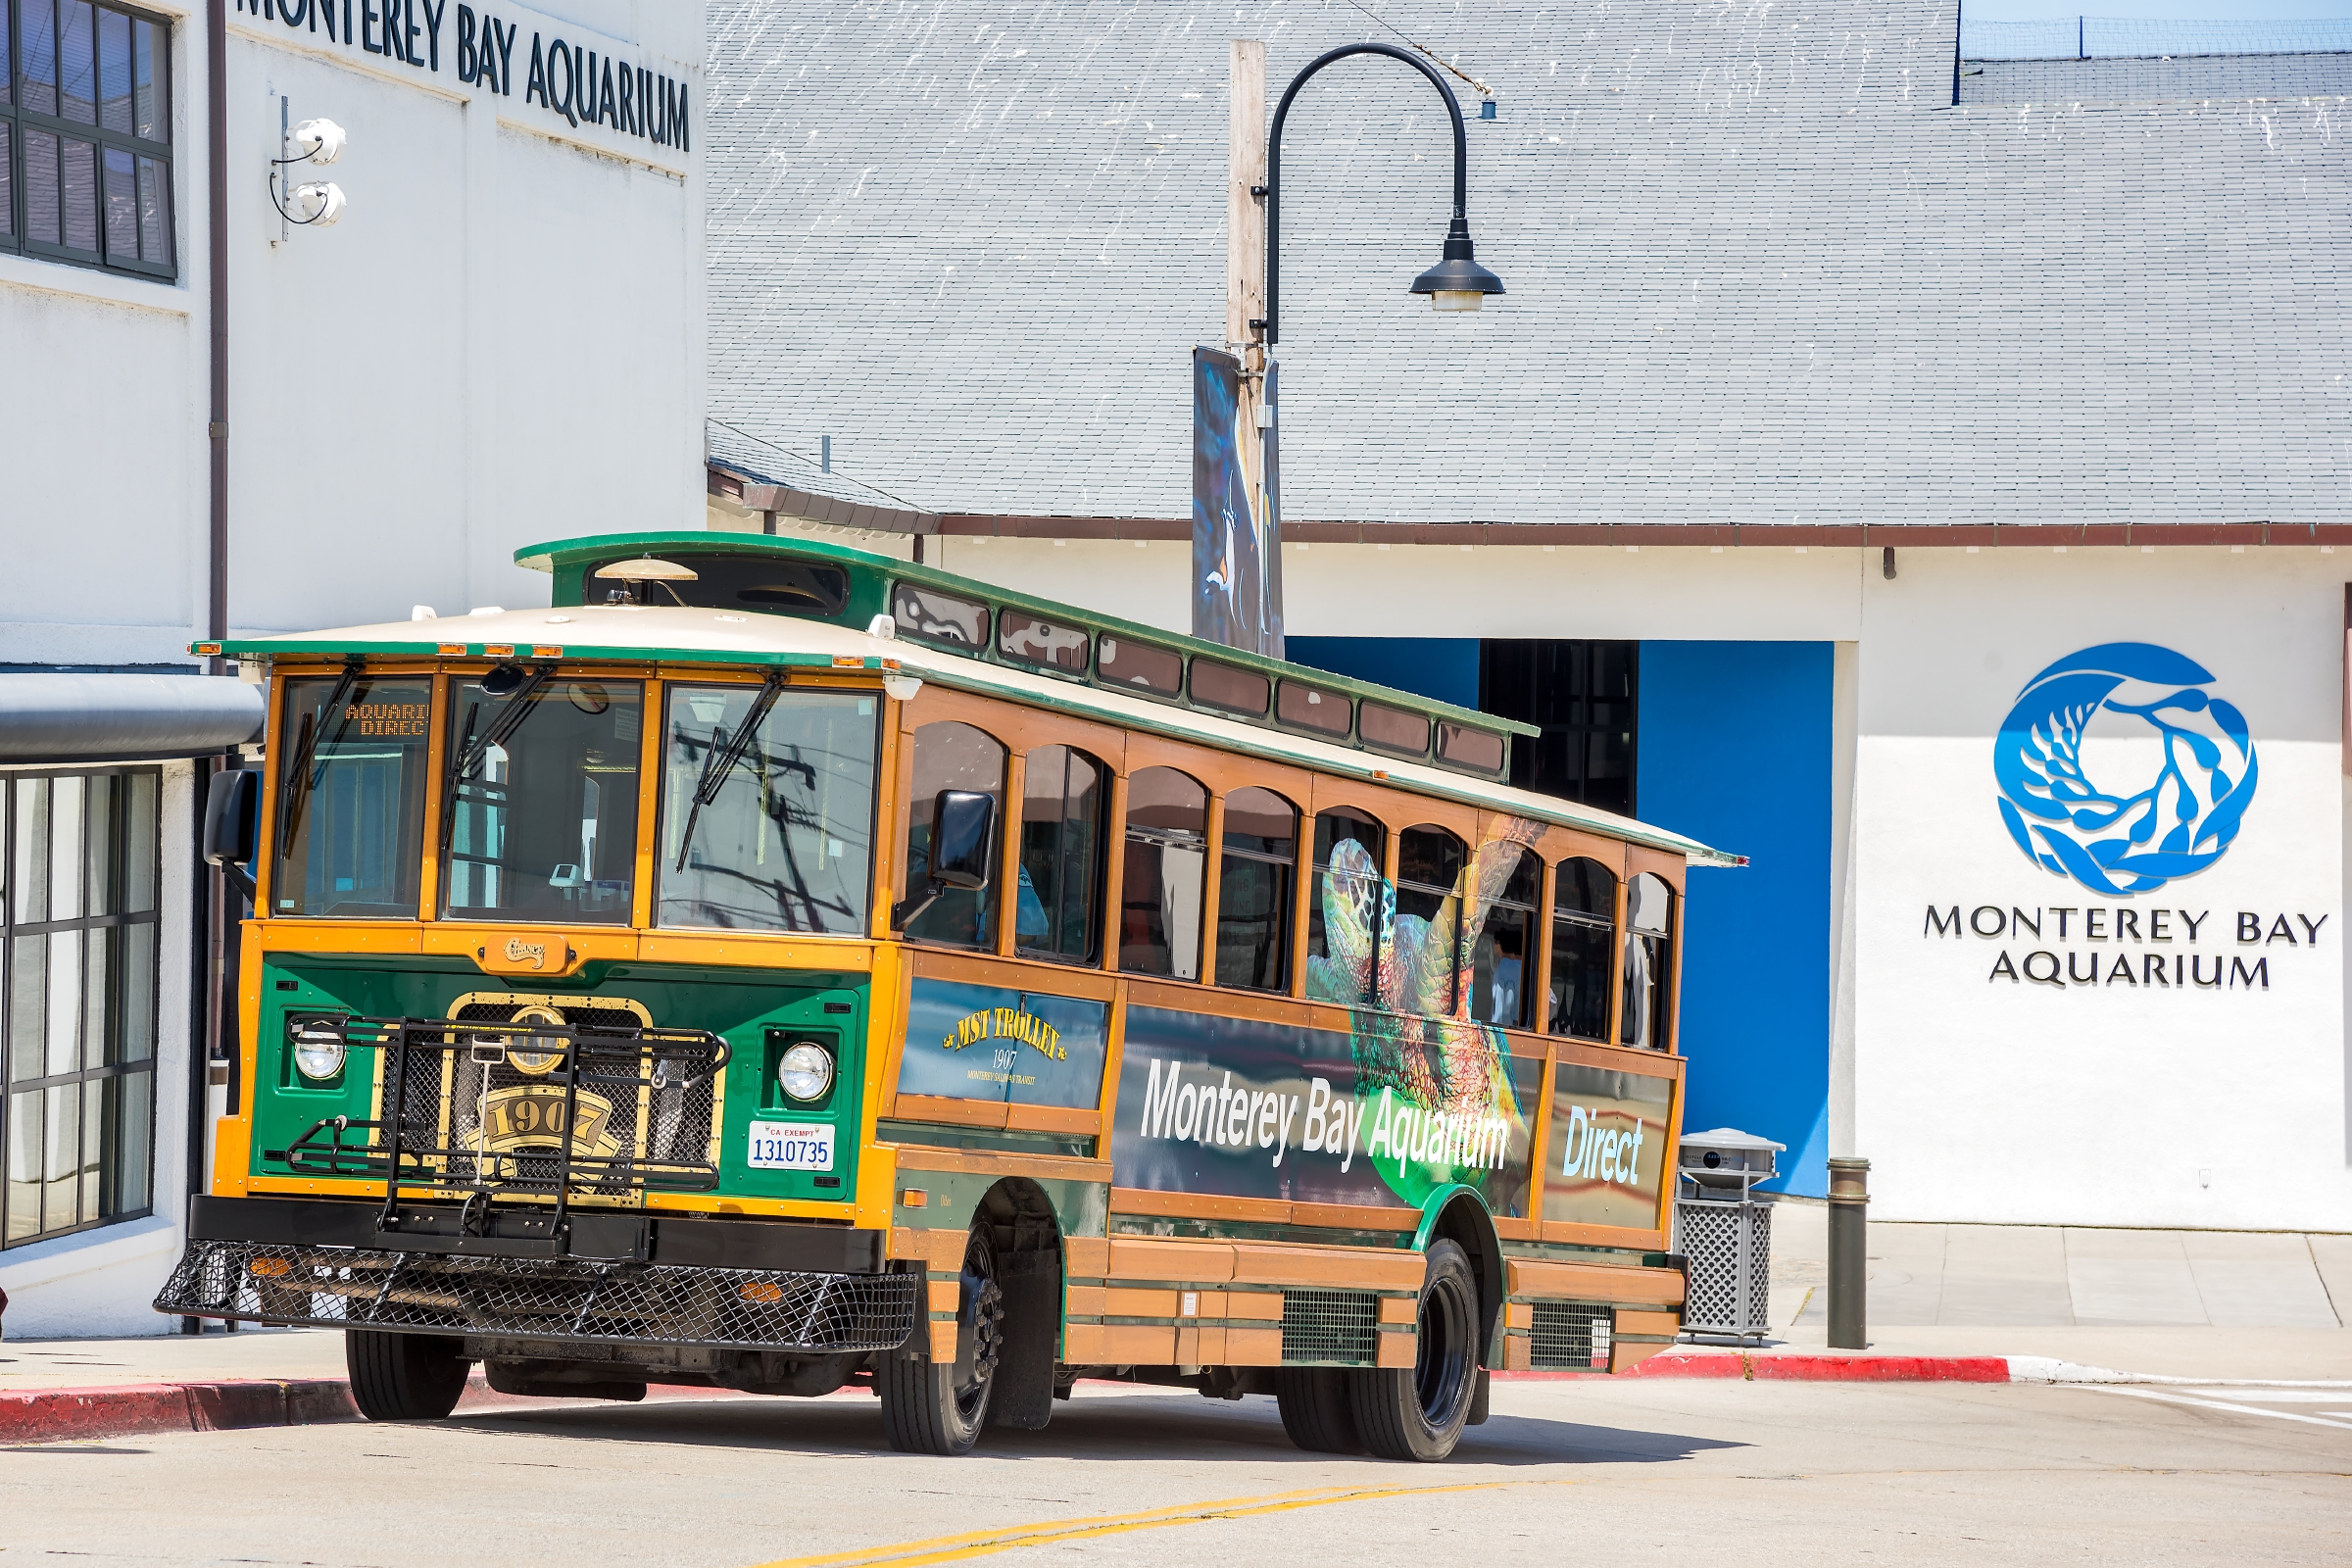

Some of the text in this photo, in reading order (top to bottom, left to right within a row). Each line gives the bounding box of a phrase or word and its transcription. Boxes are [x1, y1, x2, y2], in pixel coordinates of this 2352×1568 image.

[237, 0, 690, 153] EREY BAY AQUARIUM
[345, 704, 429, 719] AQUARI
[361, 720, 429, 736] DIREC
[1924, 905, 2329, 946] MONTEREY BAY
[1988, 950, 2269, 990] AQUARIUM
[955, 1005, 1061, 1061] MST TROLLEY
[967, 1069, 994, 1081] MONTEREY
[1015, 1074, 1036, 1086] TRANSIT
[992, 1048, 1017, 1070] 1907
[489, 1100, 604, 1141] 1907
[1140, 1057, 1508, 1179] Monterey Bay Aquarium
[753, 1139, 828, 1163] 1310735
[1562, 1104, 1643, 1186] Direct
